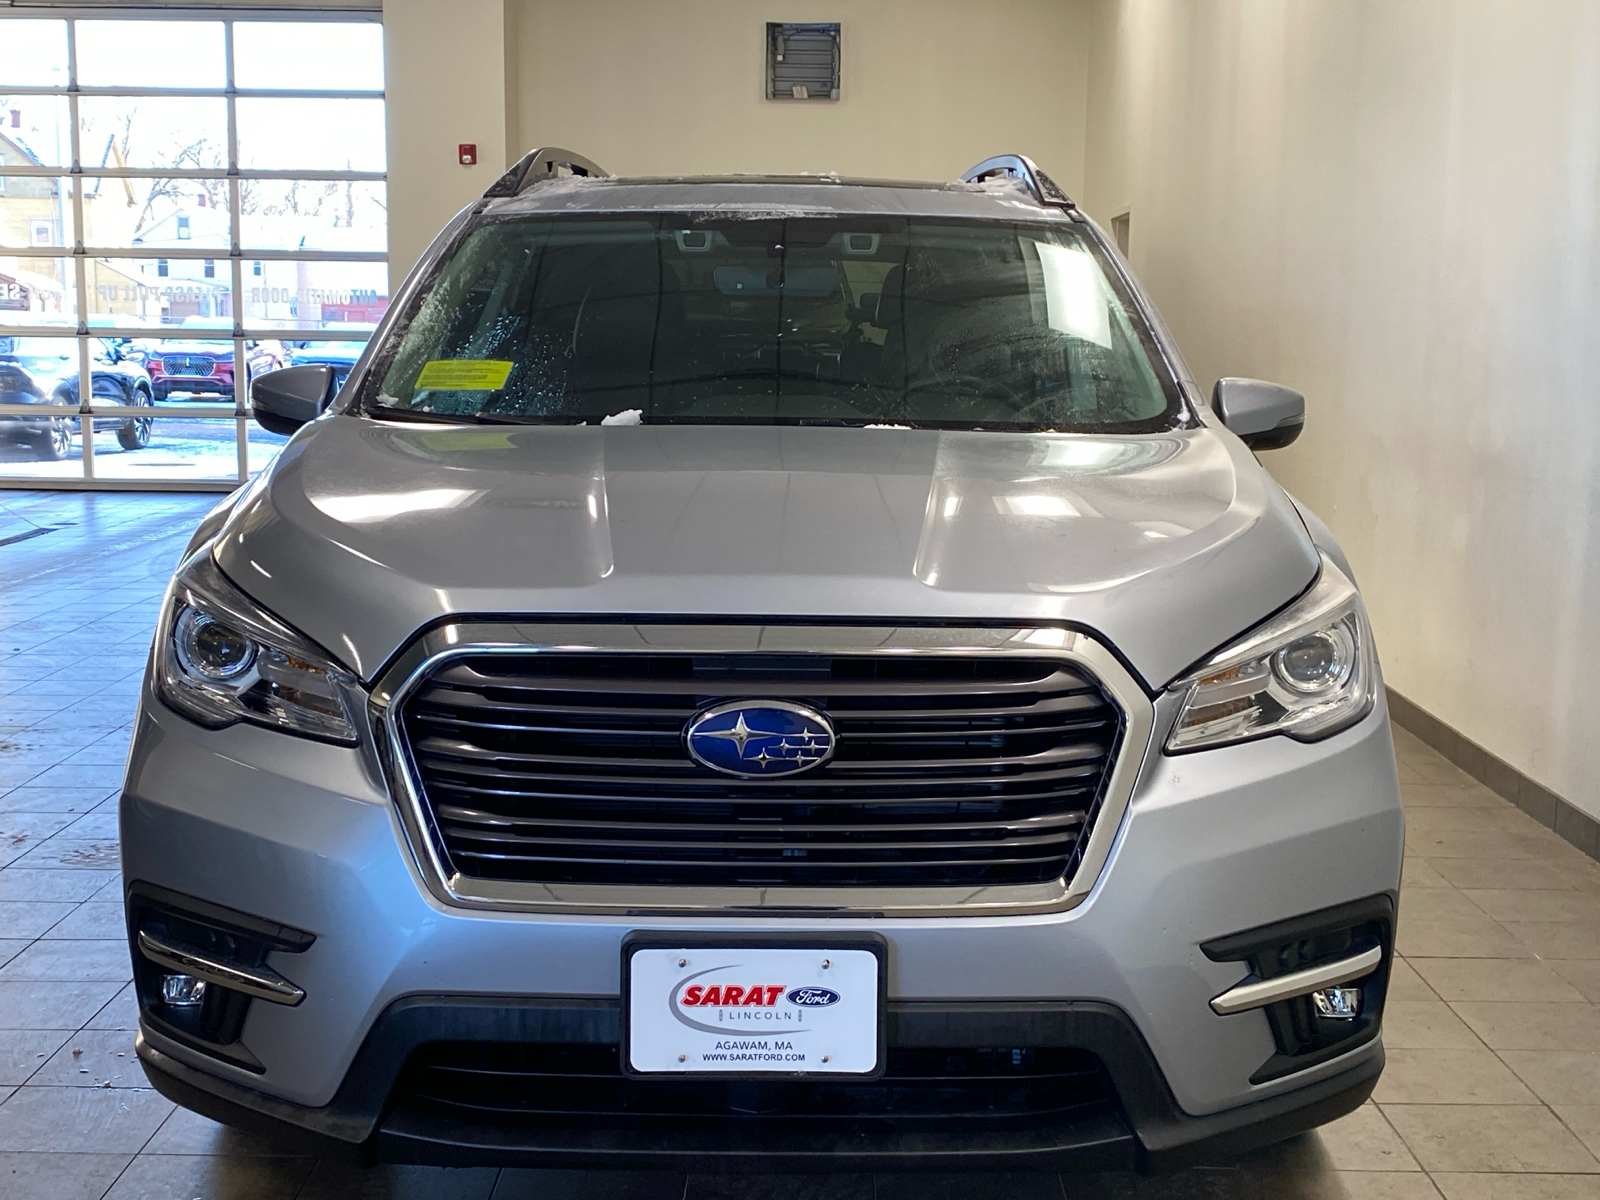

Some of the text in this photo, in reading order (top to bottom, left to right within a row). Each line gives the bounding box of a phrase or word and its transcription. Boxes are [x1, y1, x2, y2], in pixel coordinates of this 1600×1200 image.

[682, 985, 786, 1007] SARAT
[730, 1012, 792, 1020] LINCOLN
[715, 1041, 794, 1052] AGAWAM, MA
[703, 1053, 805, 1062] WWW.SARATFORD.COM
